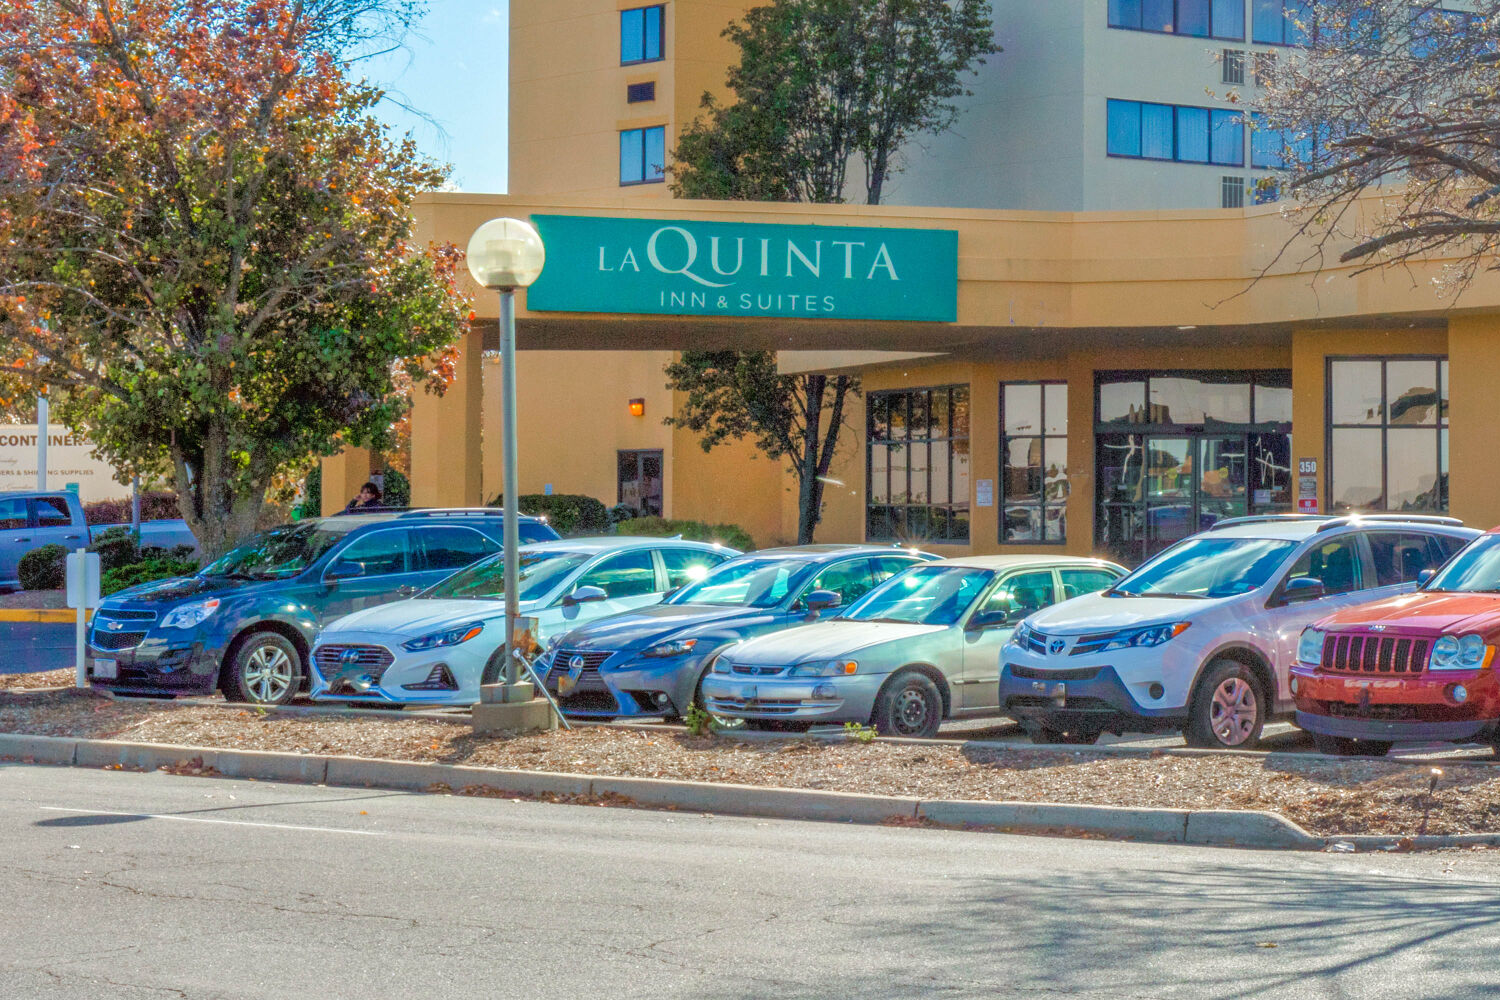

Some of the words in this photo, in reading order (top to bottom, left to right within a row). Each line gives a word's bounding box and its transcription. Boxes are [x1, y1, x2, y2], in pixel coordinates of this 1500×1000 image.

[647, 226, 899, 288] QUINTA
[660, 291, 706, 309] INN
[716, 295, 729, 309] &
[740, 293, 835, 312] SUITES
[0, 435, 82, 447] CONTINER
[1299, 461, 1317, 473] 350
